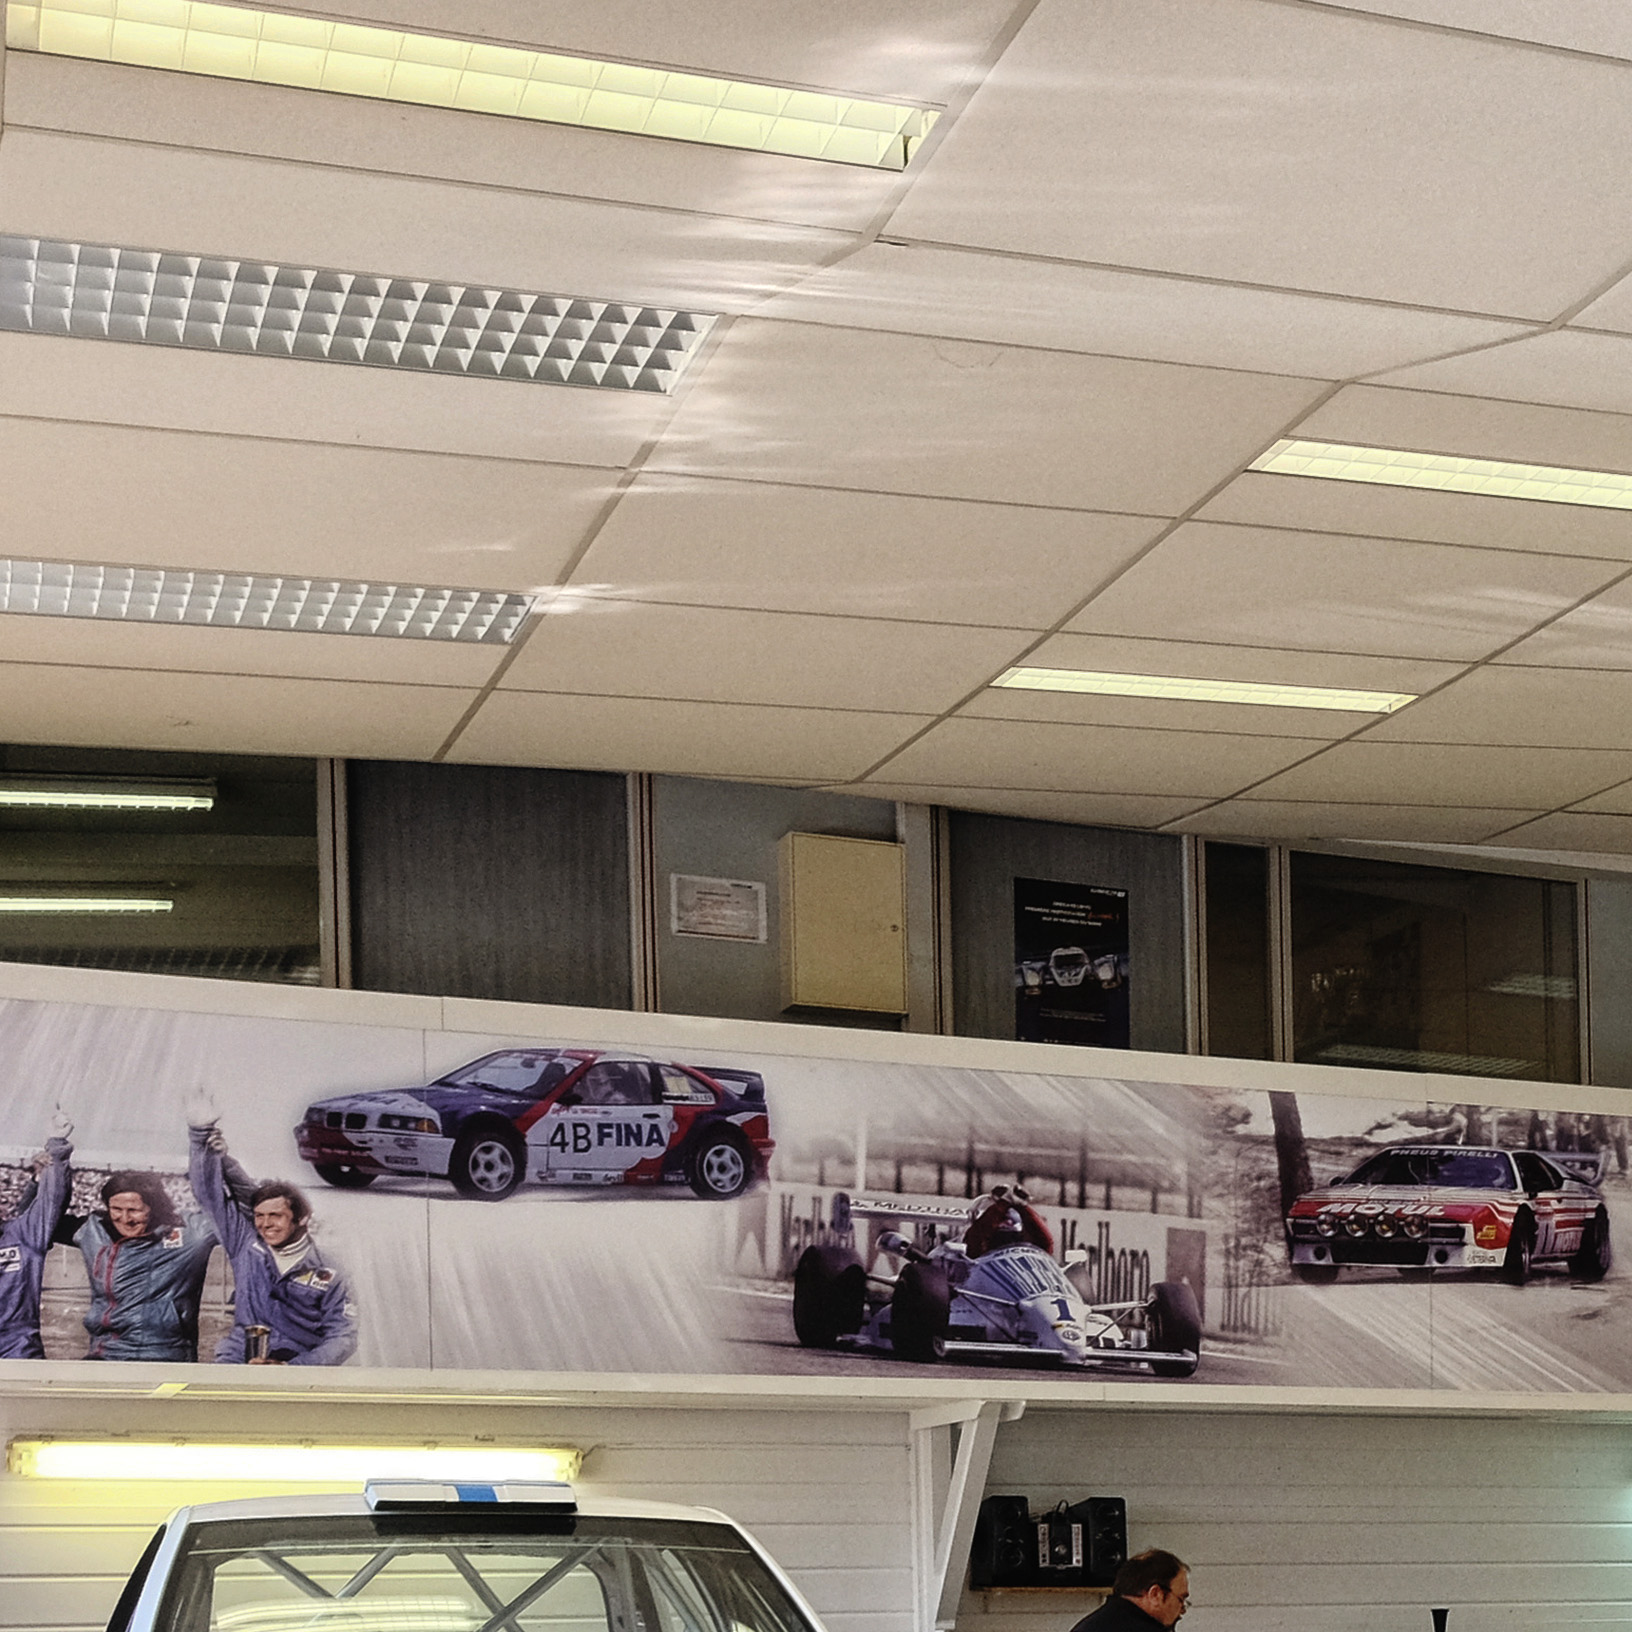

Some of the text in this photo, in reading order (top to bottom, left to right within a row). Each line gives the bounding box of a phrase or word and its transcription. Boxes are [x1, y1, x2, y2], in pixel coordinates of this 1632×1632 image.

[550, 1122, 665, 1153] 4B FINA
[1443, 1150, 1499, 1159] PIRELLI
[1317, 1201, 1446, 1217] MOTUL
[1050, 1299, 1076, 1322] 1
